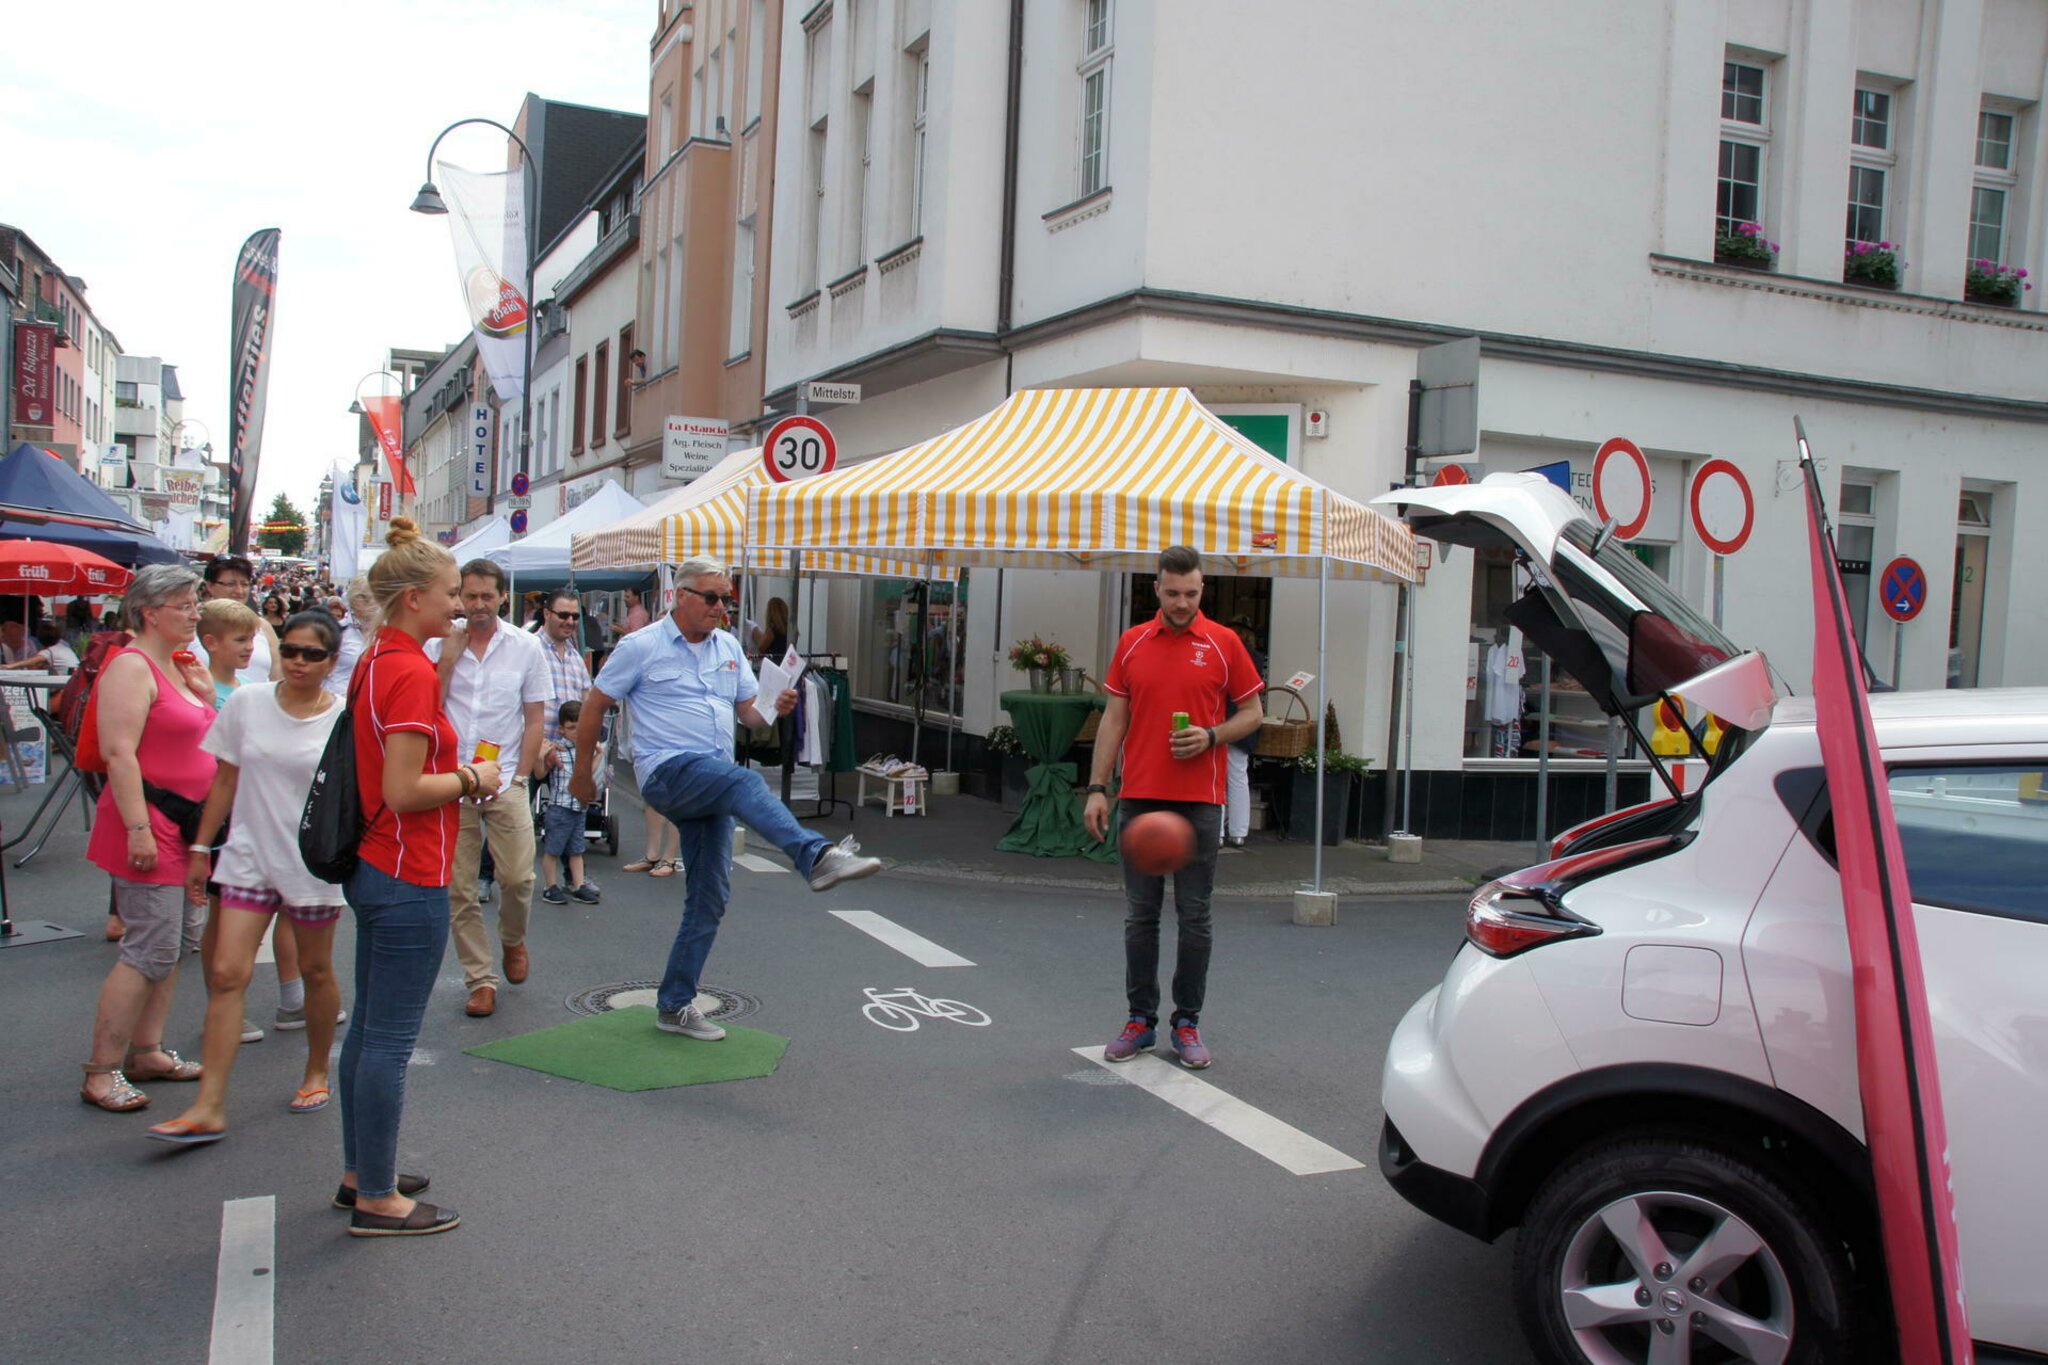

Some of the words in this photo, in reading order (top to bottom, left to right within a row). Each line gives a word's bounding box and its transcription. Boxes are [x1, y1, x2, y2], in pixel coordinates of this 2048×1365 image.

[812, 386, 858, 400] Mittelstr.
[668, 422, 682, 431] La
[684, 424, 728, 435] Estancia
[475, 409, 488, 491] HOTEL
[692, 440, 722, 449] Fleisch
[684, 451, 709, 461] Weine
[778, 436, 821, 471] 30
[171, 491, 199, 505] uchen
[19, 564, 49, 580] früh
